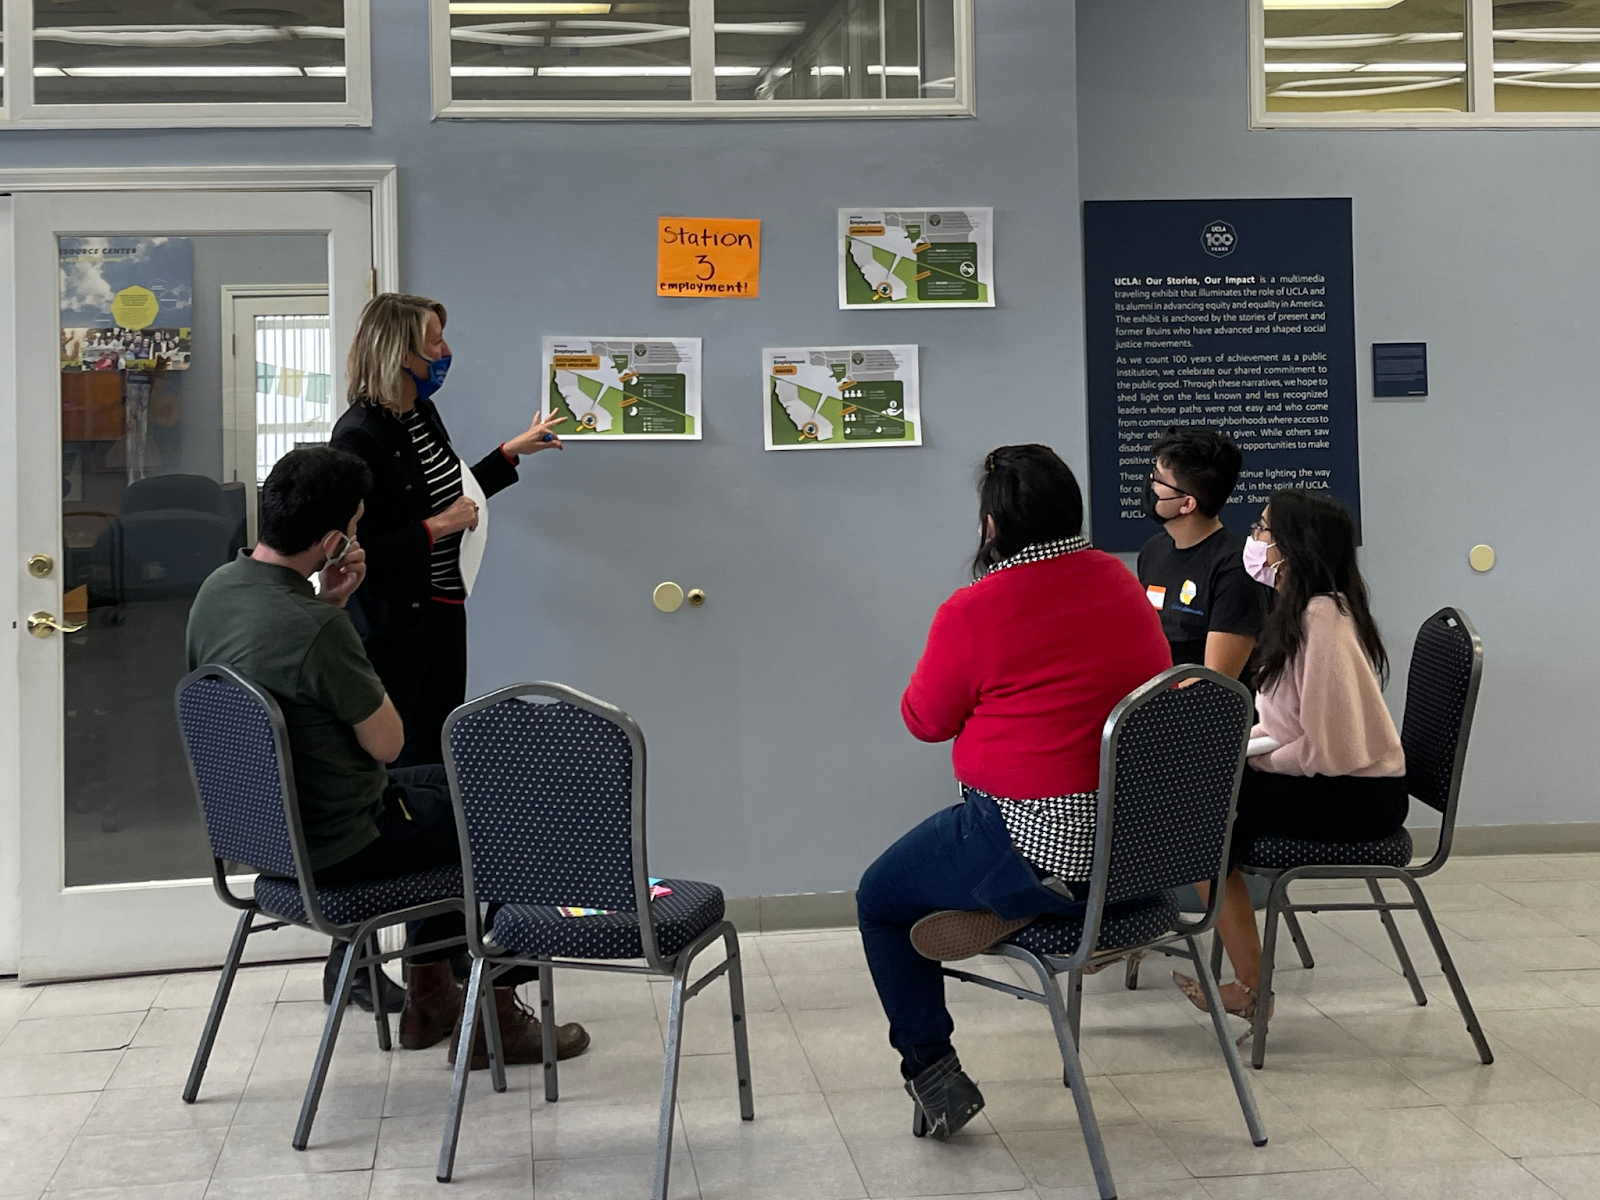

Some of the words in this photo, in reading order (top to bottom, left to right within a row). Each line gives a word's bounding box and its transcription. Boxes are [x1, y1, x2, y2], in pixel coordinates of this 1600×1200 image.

[663, 226, 752, 249] Station
[1205, 233, 1234, 246] 100
[695, 254, 715, 281] 3
[1114, 276, 1141, 285] UCLA:
[1146, 276, 1162, 285] Our
[1166, 275, 1200, 286] Stories,
[1204, 275, 1221, 284] Our
[1225, 274, 1256, 286] Impact
[1259, 274, 1266, 283] is
[1280, 273, 1325, 283] multimedia
[660, 281, 749, 293] employment!
[1114, 289, 1150, 301] traveling
[1151, 289, 1179, 298] exhibit
[1180, 289, 1197, 298] that
[1198, 288, 1242, 297] illuminates
[1243, 288, 1257, 297] the
[1258, 288, 1275, 296] role
[1276, 287, 1284, 296] of
[1286, 287, 1308, 296] UCLA
[1310, 287, 1325, 296] and
[1115, 302, 1124, 311] its
[1126, 302, 1153, 310] alumni
[1154, 302, 1162, 310] in
[1163, 301, 1204, 312] advancing
[1205, 301, 1231, 312] equity
[1232, 300, 1247, 309] and
[1248, 300, 1280, 311] equality
[1281, 300, 1289, 308] in
[1290, 299, 1325, 308] America.
[1115, 314, 1131, 323] The
[1132, 314, 1160, 323] exhibit
[1162, 314, 1169, 322] is
[1170, 313, 1209, 322] anchored
[1211, 313, 1221, 324] by
[1223, 313, 1237, 322] the
[1239, 312, 1266, 321] stories
[1267, 312, 1277, 321] of
[1278, 313, 1308, 323] present
[1310, 312, 1326, 320] and
[1115, 327, 1143, 336] former
[1146, 326, 1171, 335] Bruins
[1173, 326, 1191, 335] who
[1192, 326, 1212, 334] have
[1214, 325, 1252, 334] advanced
[1254, 325, 1270, 334] and
[1272, 324, 1301, 336] shaped
[1303, 324, 1326, 333] social
[1115, 339, 1142, 351] justice
[1144, 340, 1193, 348] movements.
[1116, 355, 1127, 364] As
[1145, 355, 1169, 364] count
[1172, 354, 1187, 363] 100
[1190, 356, 1212, 365] years
[1215, 354, 1224, 362] of
[1227, 353, 1278, 362] achievement
[1302, 352, 1327, 364] public
[1116, 367, 1160, 378] institution,
[1177, 366, 1215, 376] celebrate
[1234, 366, 1261, 375] shared
[1263, 365, 1316, 374] commitment
[1318, 365, 1327, 373] to
[1117, 380, 1131, 389] the
[1132, 380, 1156, 391] public
[1157, 379, 1181, 391] good.
[1182, 379, 1218, 390] Through
[1218, 378, 1240, 387] these
[1241, 378, 1282, 388] narratives,
[1296, 377, 1318, 388] hope
[1318, 378, 1328, 386] to
[1117, 393, 1137, 402] shed
[1140, 392, 1159, 403] light
[1177, 392, 1192, 400] the
[1195, 391, 1210, 400] less
[1214, 391, 1242, 400] known
[1245, 391, 1260, 399] and
[1264, 390, 1279, 399] less
[1283, 390, 1328, 401] recognized
[1118, 405, 1147, 414] leaders
[1150, 404, 1176, 414] whose
[1179, 404, 1202, 415] paths
[1228, 404, 1242, 412] not
[1246, 405, 1263, 414] easy
[1266, 403, 1282, 412] and
[1285, 402, 1302, 411] who
[1118, 418, 1137, 426] from
[1138, 417, 1190, 426] communities
[1190, 416, 1205, 425] and
[1206, 416, 1267, 427] neighborhoods
[1268, 415, 1292, 424] where
[1320, 415, 1329, 423] to
[1118, 430, 1144, 441] higher
[1233, 428, 1257, 440] given.
[1260, 428, 1282, 437] While
[1285, 427, 1311, 436] others
[1243, 440, 1296, 452] opportunities
[1298, 441, 1306, 449] to
[1307, 440, 1329, 448] make
[1119, 455, 1150, 467] positive
[1119, 472, 1144, 481] These
[1238, 470, 1264, 479] ntinue
[1265, 469, 1296, 480] lighting
[1299, 469, 1313, 478] the
[1315, 471, 1331, 480] way
[1120, 484, 1132, 493] for
[1249, 482, 1257, 491] in
[1258, 482, 1272, 491] the
[1273, 481, 1294, 493] spirit
[1295, 481, 1305, 490] of
[1306, 481, 1331, 490] UCLA.
[1120, 497, 1141, 506] What
[1248, 494, 1270, 504] Share
